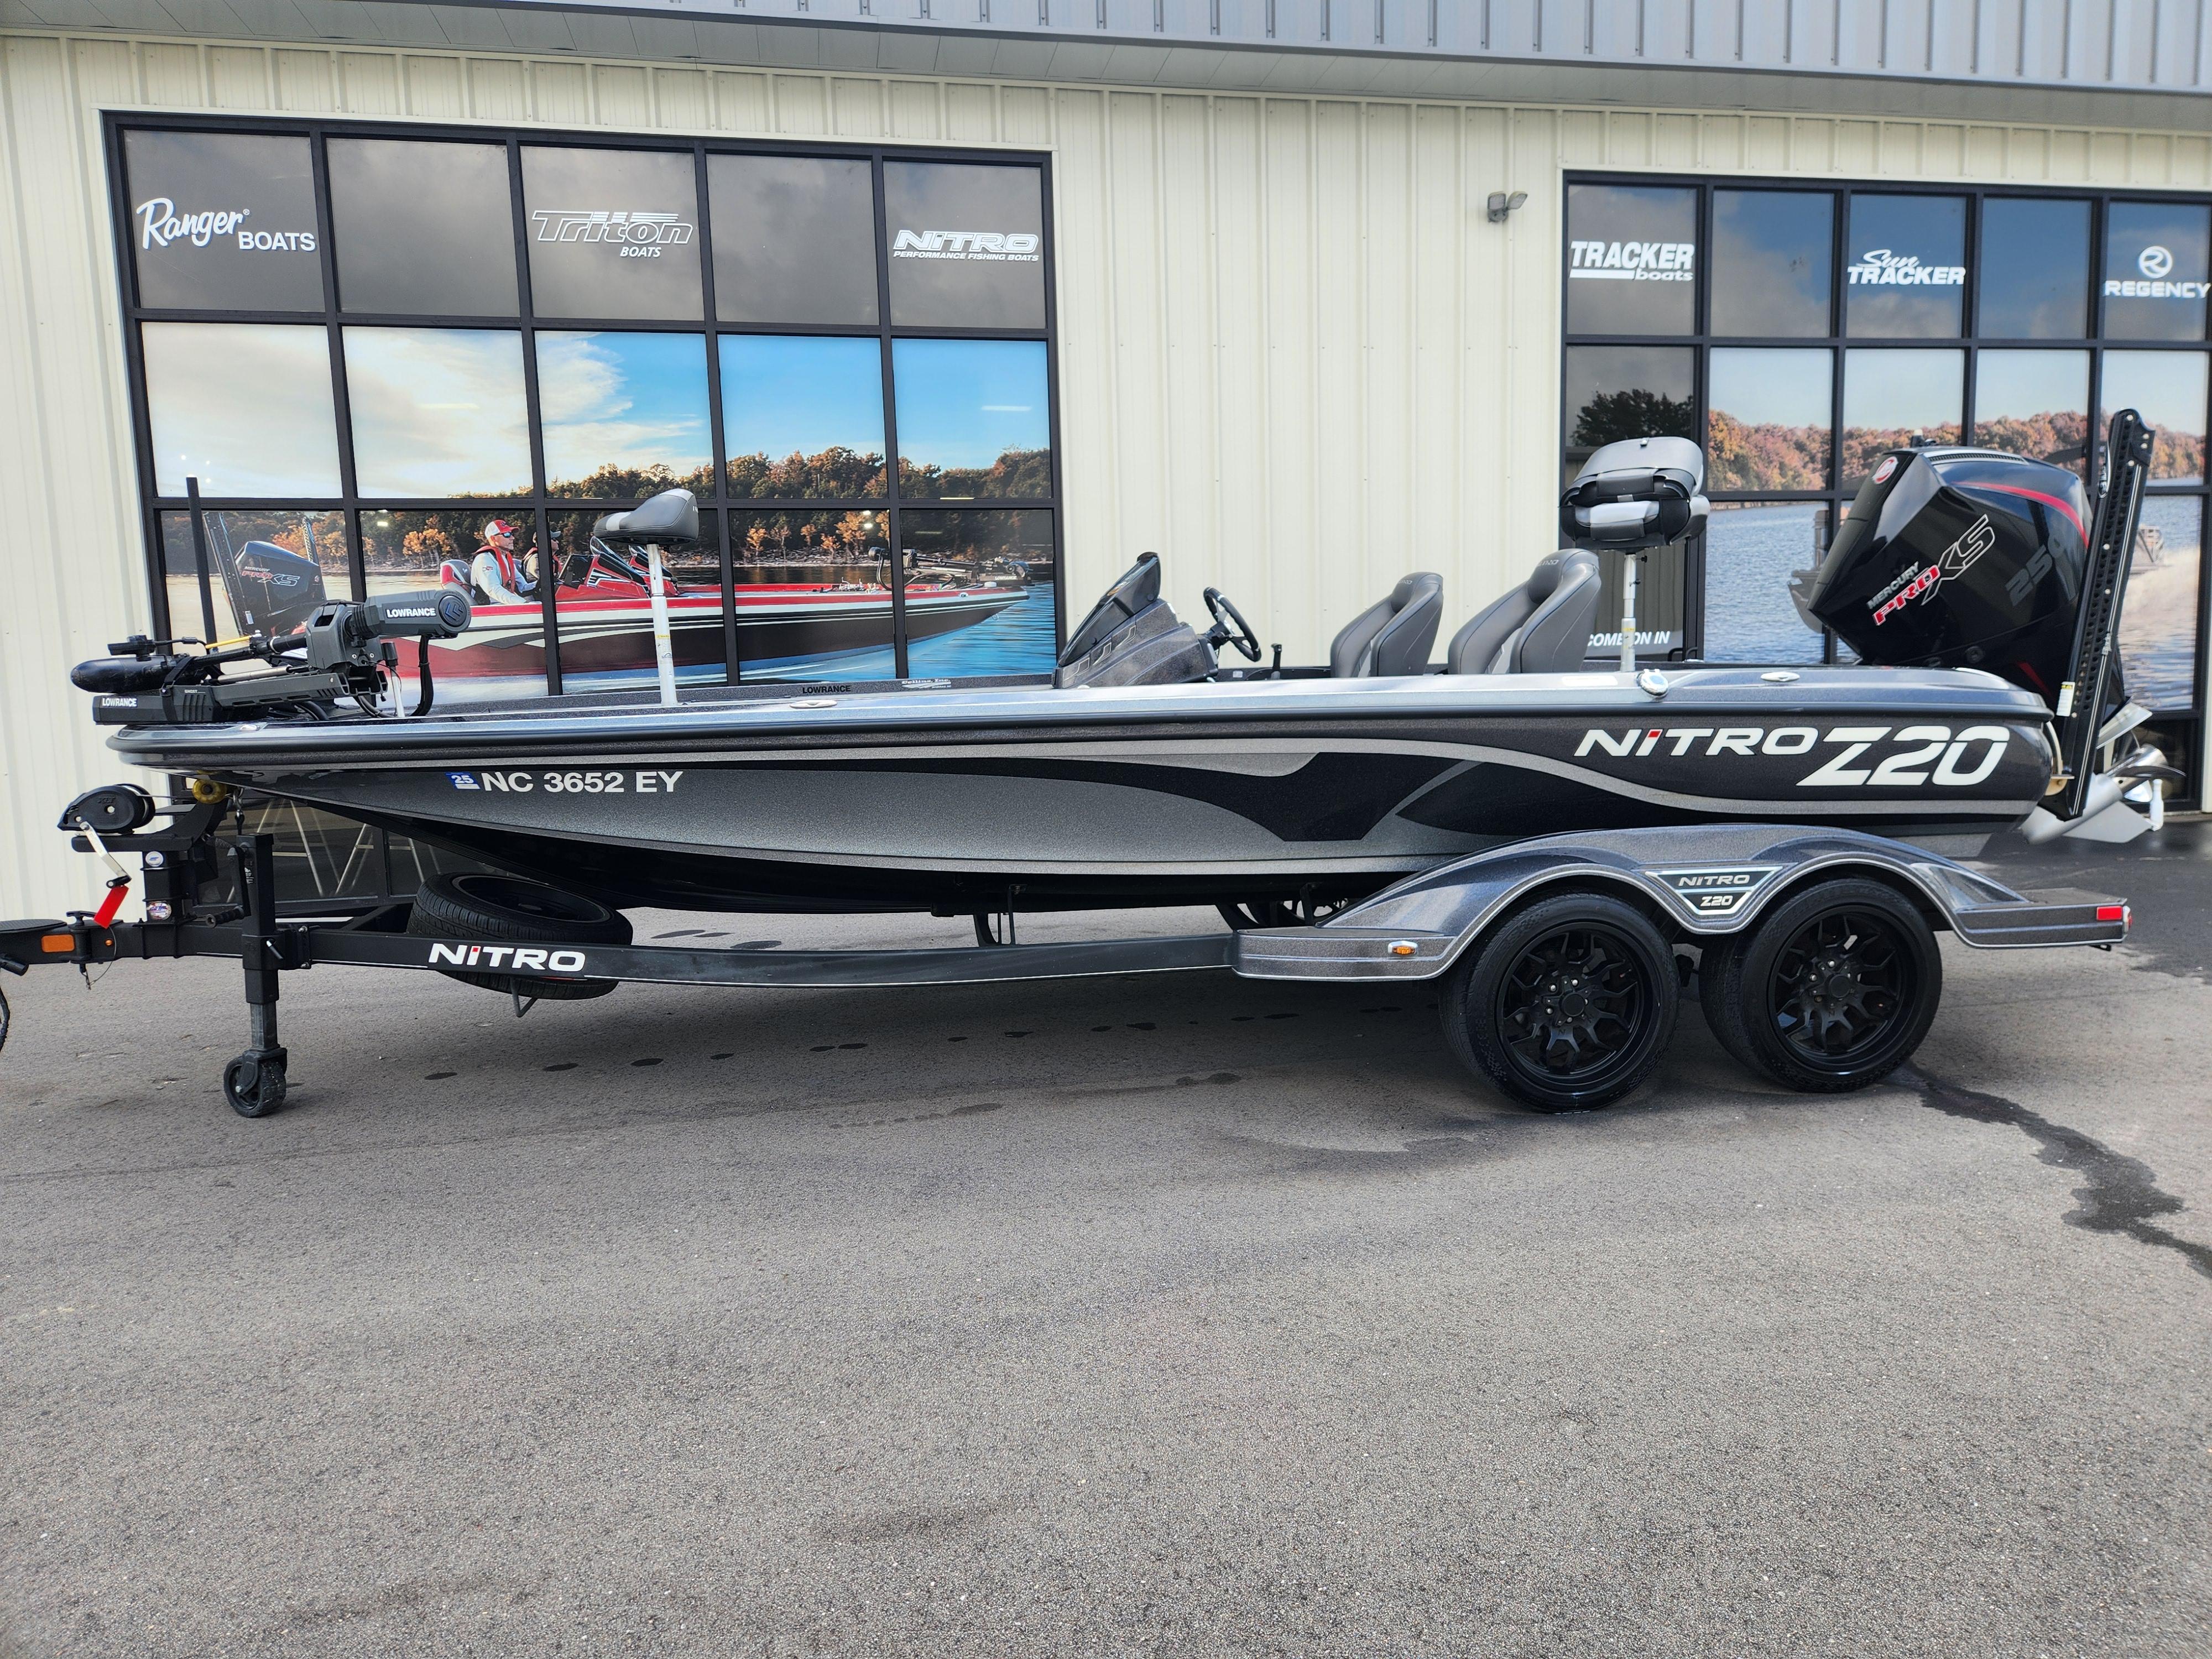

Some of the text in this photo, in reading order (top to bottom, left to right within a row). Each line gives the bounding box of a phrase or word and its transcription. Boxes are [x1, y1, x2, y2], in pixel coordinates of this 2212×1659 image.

[532, 210, 693, 244] Triton
[238, 231, 316, 251] BOATS
[620, 247, 662, 257] BOATS
[893, 251, 966, 260] PERFORMANCE
[1571, 241, 1695, 270] TRACKER
[1856, 249, 1920, 268] Sun
[1634, 268, 1694, 281] boats
[1847, 266, 1966, 285] TRACKER
[2104, 280, 2212, 299] REGENCY
[1872, 514, 1995, 626] PRO XS
[1866, 561, 1919, 609] MERCURY
[386, 608, 436, 618] LOWRANCE
[1654, 631, 1671, 644] IN
[802, 685, 851, 694] LOWRANCE
[102, 697, 138, 707] LOWRANCE
[1795, 726, 2010, 786] Z20
[451, 775, 474, 784] 25
[482, 771, 684, 792] NC 3652 EY
[1700, 895, 1733, 907] Z20
